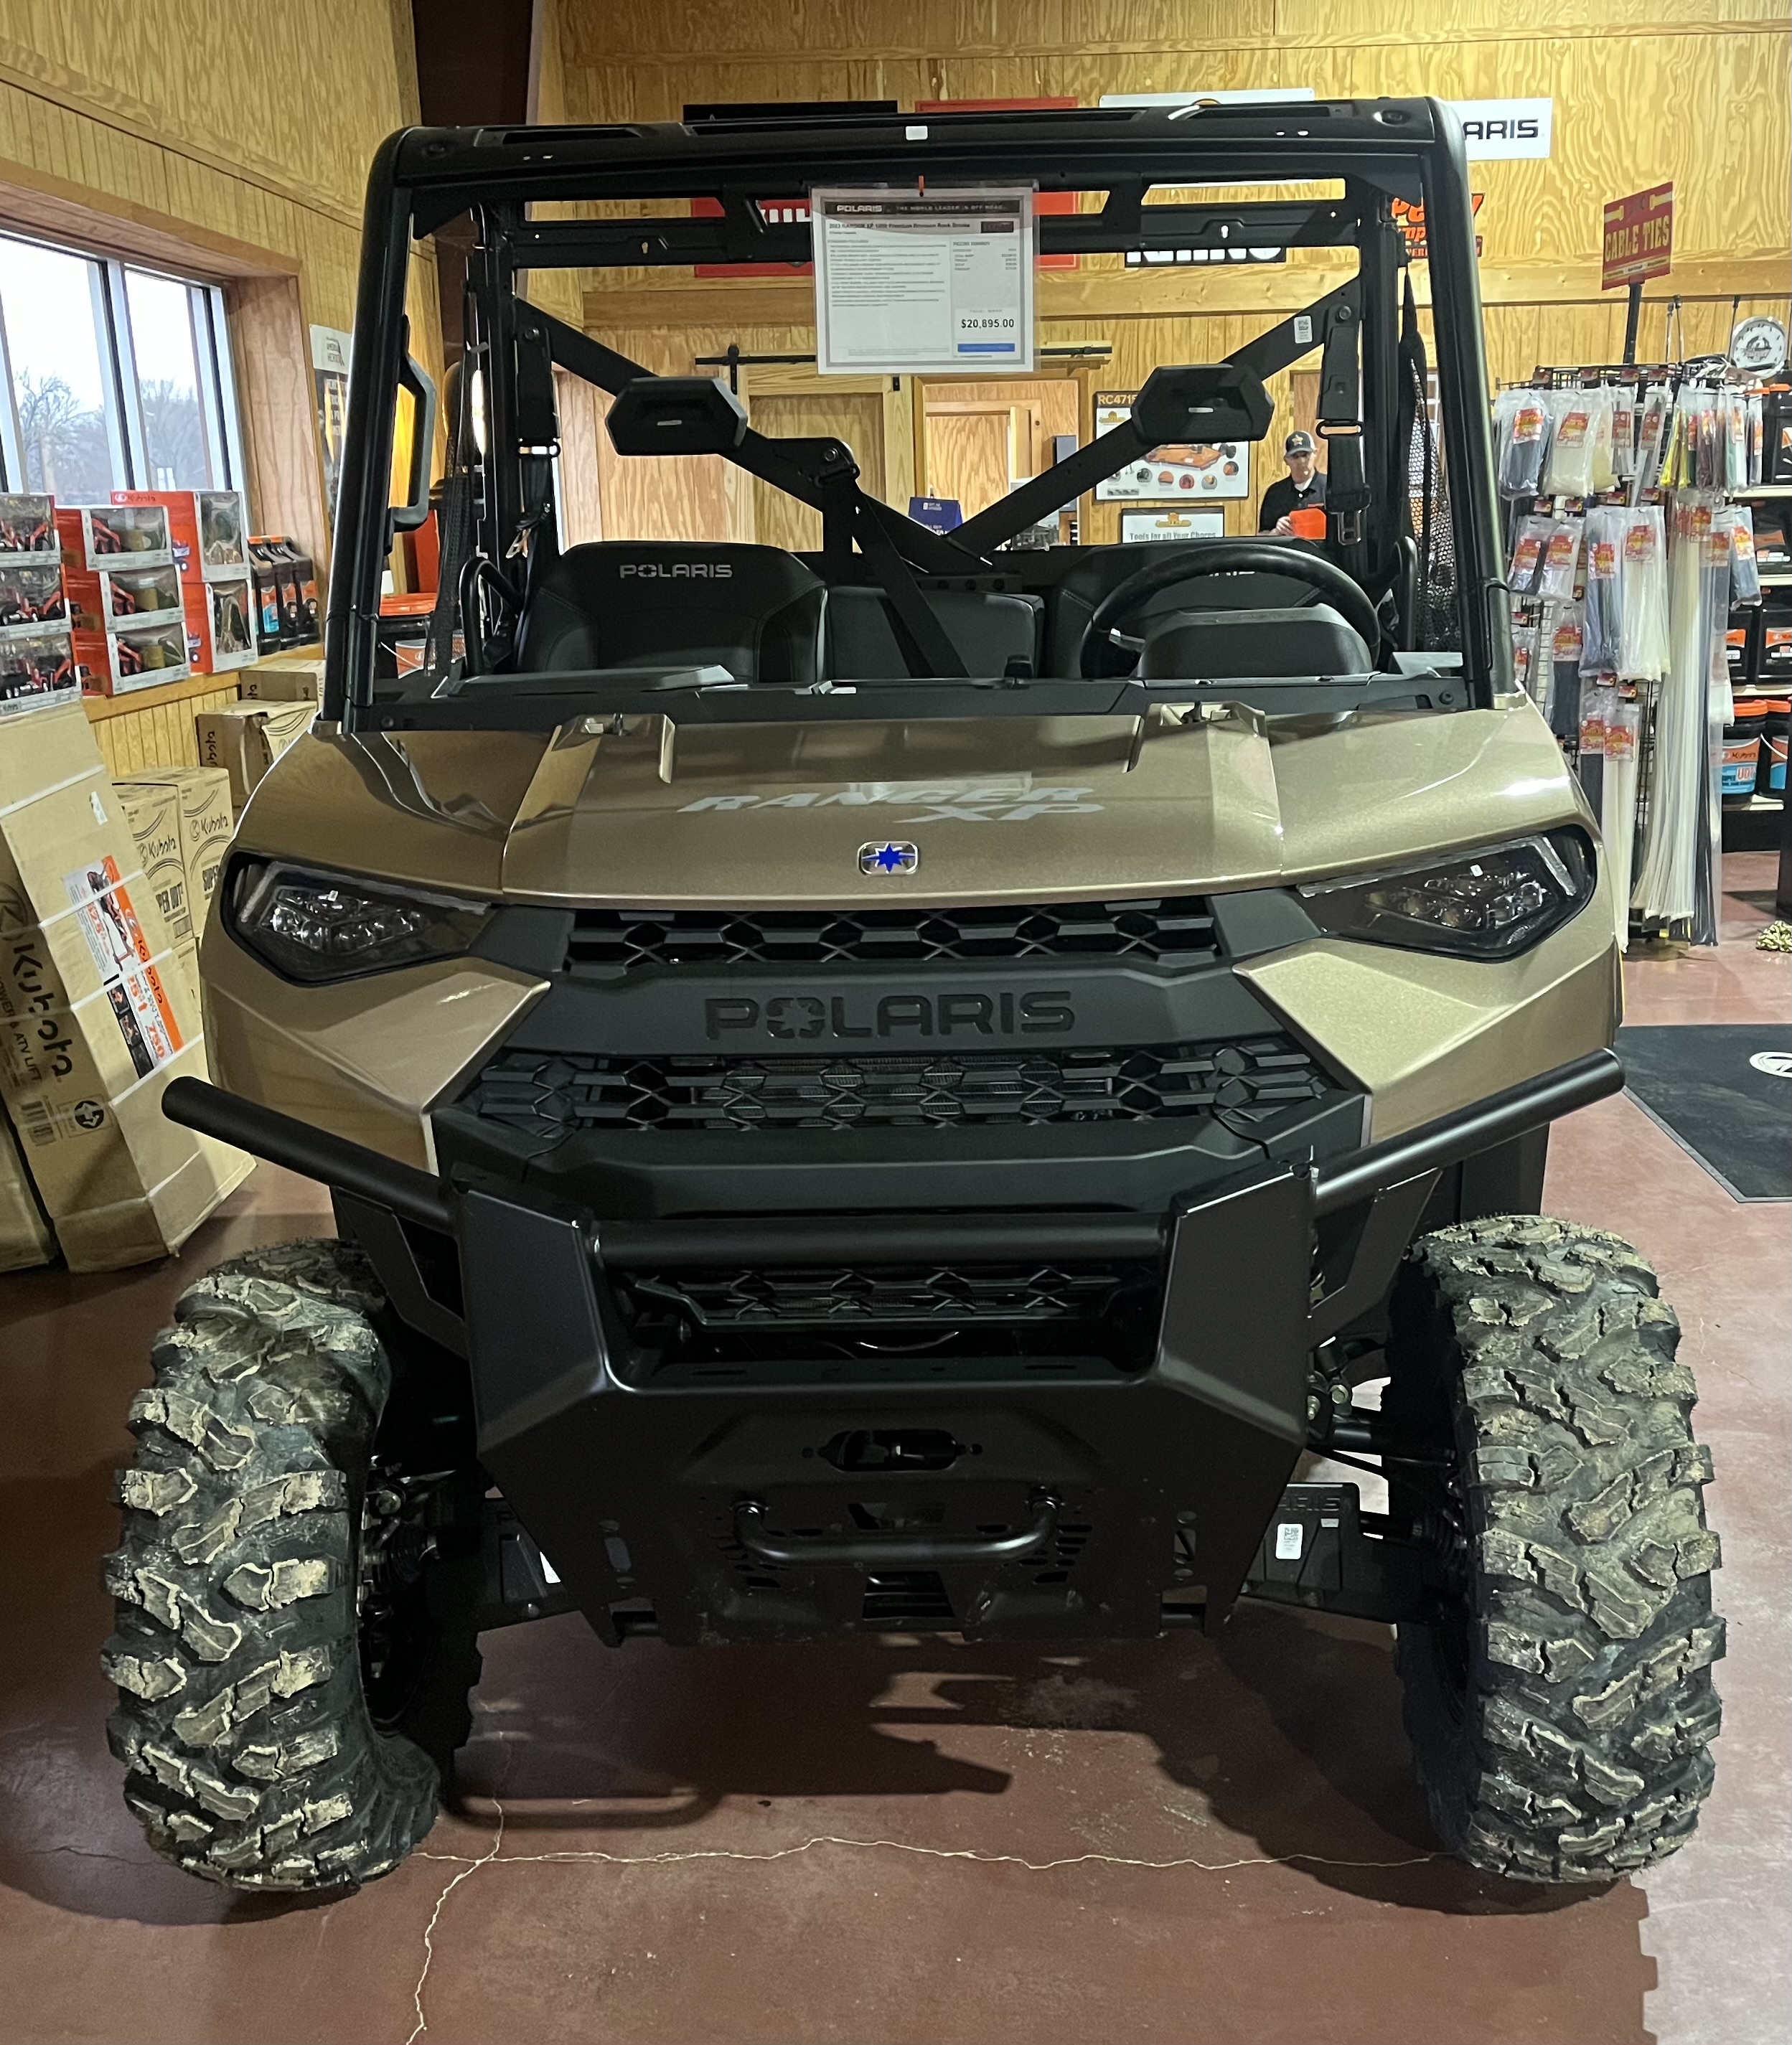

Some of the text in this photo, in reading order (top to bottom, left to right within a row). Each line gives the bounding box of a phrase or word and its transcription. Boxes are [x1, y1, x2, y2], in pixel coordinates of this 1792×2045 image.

[836, 204, 883, 213] POLARIS
[1605, 215, 1670, 262] CABLE TIES
[961, 319, 1015, 329] $20,895.00
[1130, 532, 1150, 541] Tools
[619, 563, 733, 579] POLARIS
[677, 787, 1094, 813] RANGER
[200, 812, 229, 835] Kubota
[893, 803, 1106, 824] XP
[148, 835, 177, 859] Kubota
[12, 943, 73, 1078] Kubota
[704, 990, 1076, 1041] POLARIS
